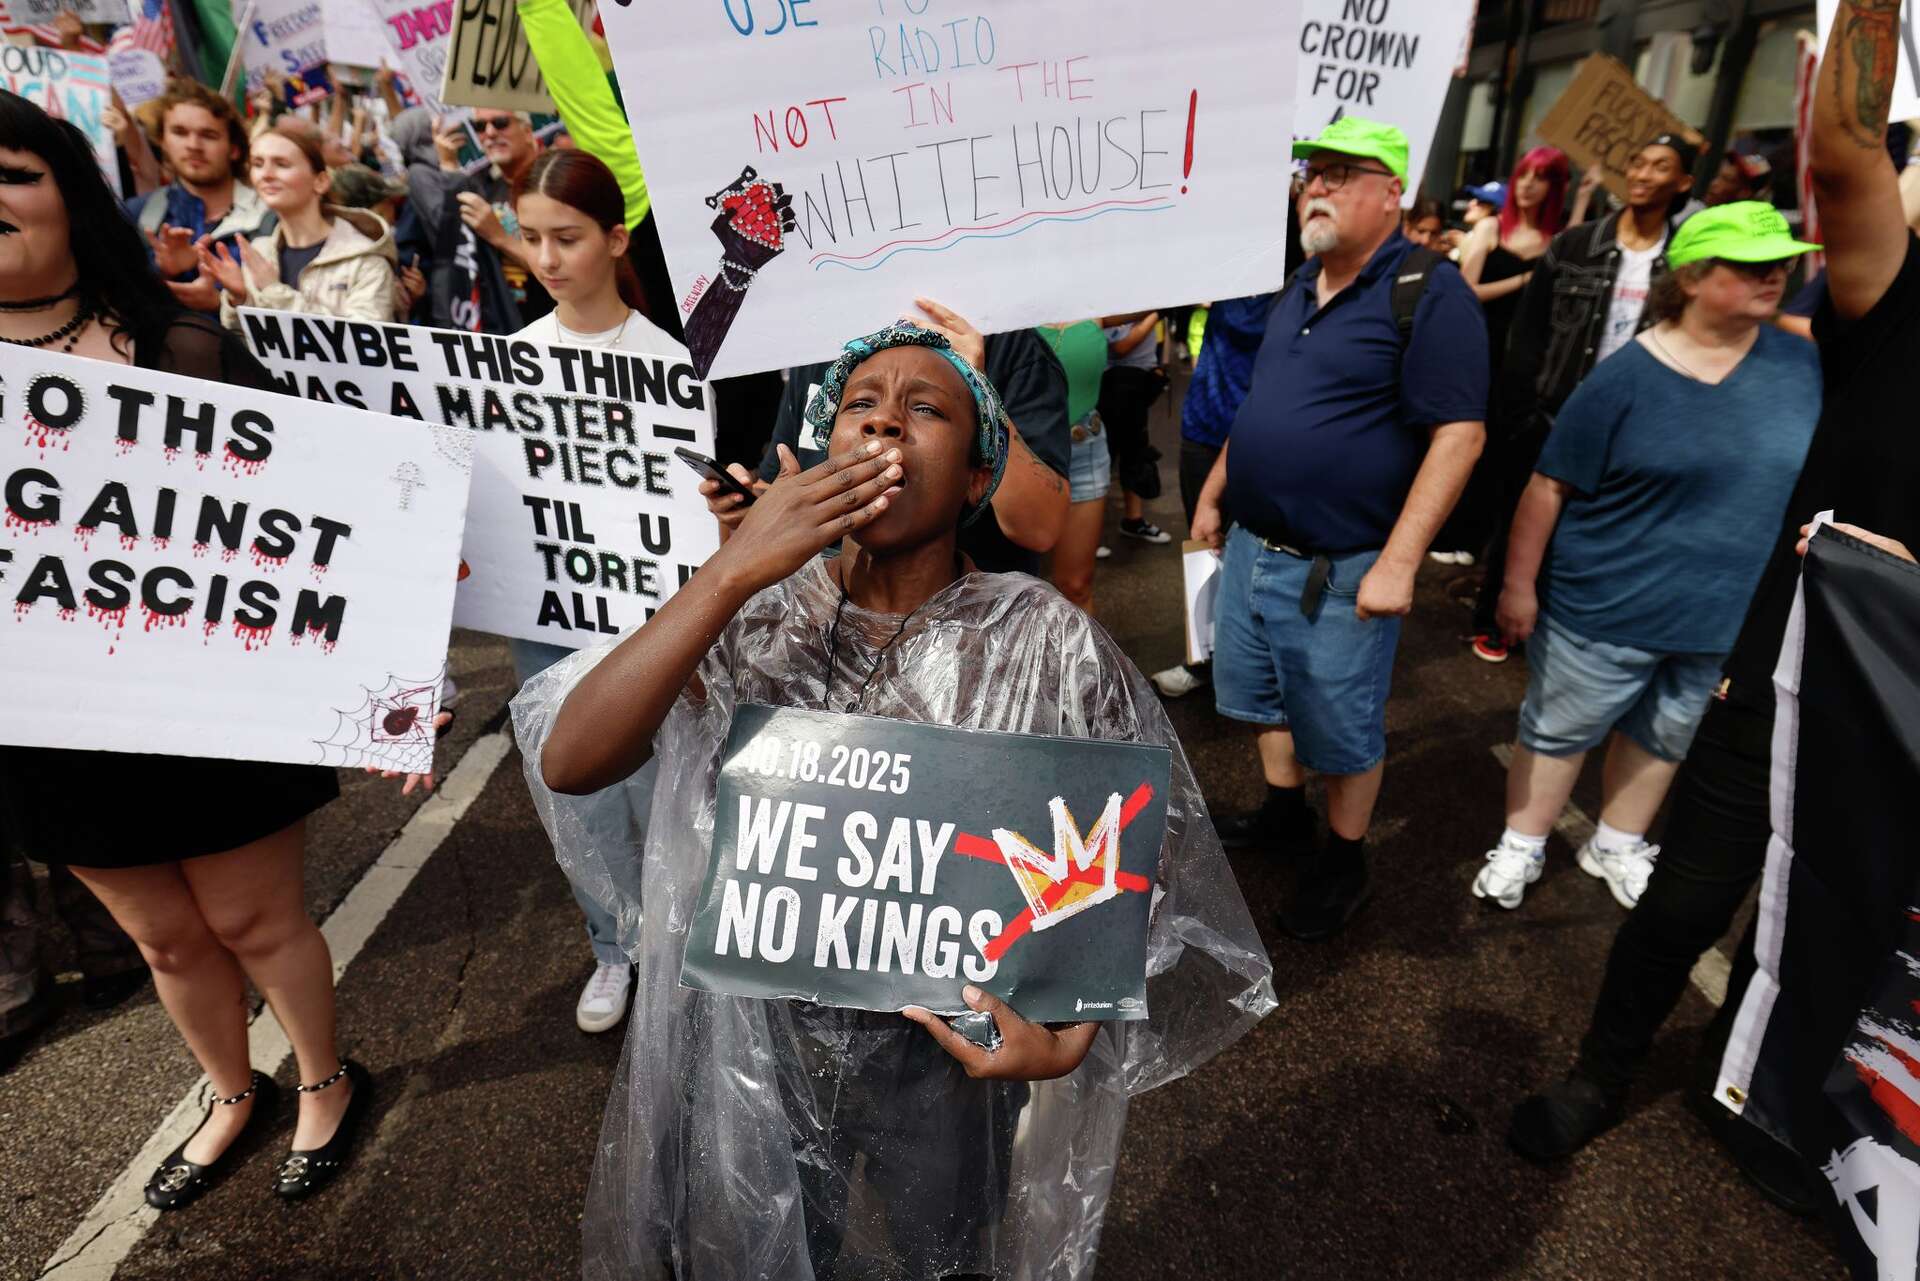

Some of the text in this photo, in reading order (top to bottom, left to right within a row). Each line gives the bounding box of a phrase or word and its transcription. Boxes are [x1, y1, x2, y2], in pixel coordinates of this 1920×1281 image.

[868, 15, 995, 79] RADIO
[1300, 21, 1420, 69] CROWN
[893, 81, 955, 129] IN
[996, 55, 1094, 102] THE
[1312, 63, 1381, 106] FOR
[245, 313, 419, 372] MAYBE
[431, 332, 545, 388] THIS
[550, 346, 705, 412] THING
[0, 372, 276, 463] OTHS
[390, 381, 425, 421] A
[523, 437, 674, 497] PIECE
[523, 494, 672, 555] TIL U
[534, 542, 661, 598] TORE
[537, 589, 620, 634] ALL
[735, 794, 957, 896] WE SAY
[713, 878, 1004, 984] NO KINGS
